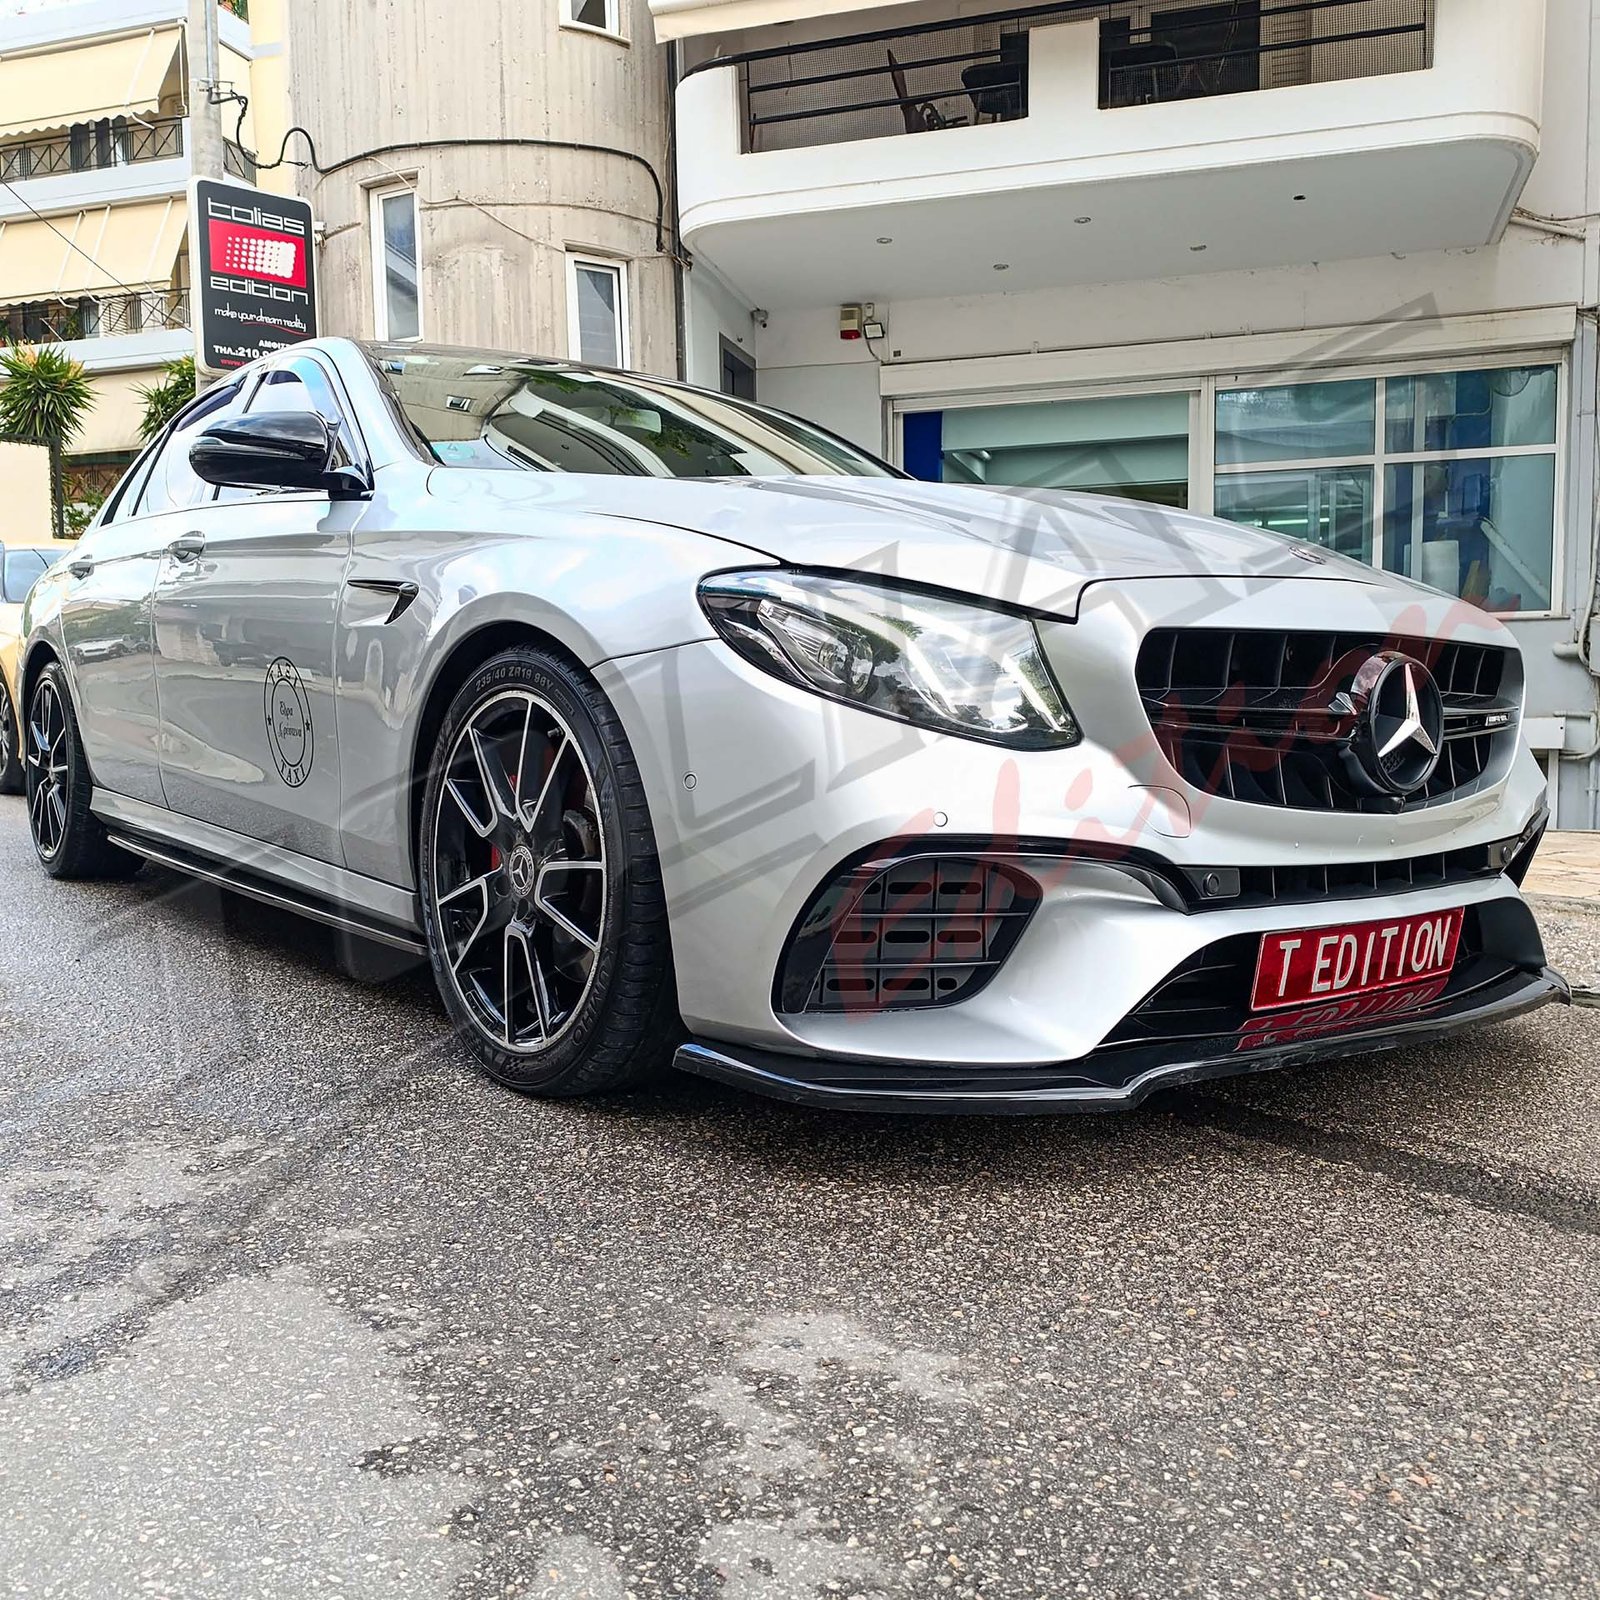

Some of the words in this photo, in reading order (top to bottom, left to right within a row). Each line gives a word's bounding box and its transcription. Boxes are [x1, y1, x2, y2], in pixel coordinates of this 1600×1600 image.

[207, 196, 305, 235] tolias
[210, 275, 309, 305] edition
[214, 302, 236, 319] make
[238, 311, 256, 322] your
[256, 307, 282, 326] dream
[283, 314, 306, 332] reality
[475, 667, 506, 692] 235/40
[508, 666, 532, 680] ZR19
[281, 759, 306, 784] TAXI
[1277, 938, 1302, 997] T
[1310, 914, 1453, 993] EDITION
